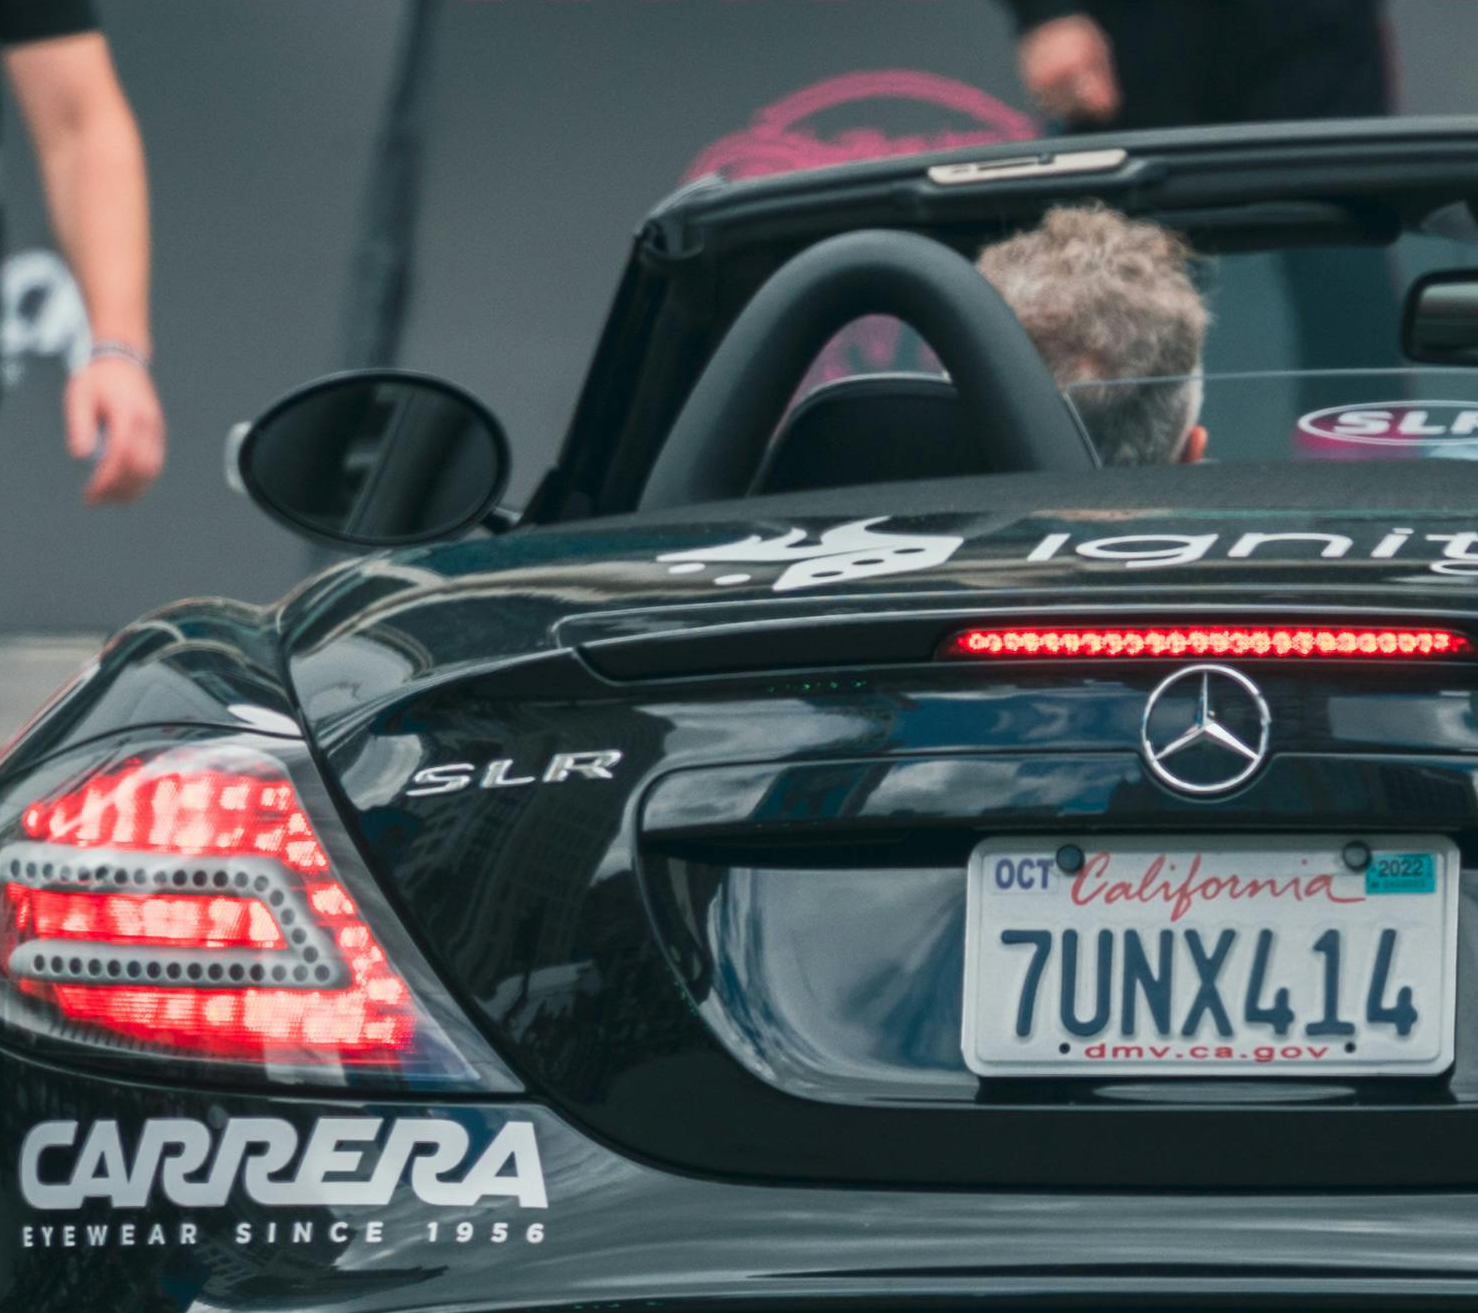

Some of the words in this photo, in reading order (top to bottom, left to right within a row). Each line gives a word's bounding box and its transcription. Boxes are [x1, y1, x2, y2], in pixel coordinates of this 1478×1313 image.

[405, 748, 623, 797] SLR
[994, 857, 1054, 891] OCT
[1071, 851, 1366, 922] California
[1378, 859, 1423, 878] 2022
[1001, 928, 1419, 1037] 7UNX414
[1084, 1041, 1331, 1063] dmv.ca.gov
[20, 1117, 549, 1210] CARRERA
[22, 1223, 198, 1247] EYEWEAR
[236, 1221, 384, 1245] SINCE
[427, 1220, 546, 1244] 1956
